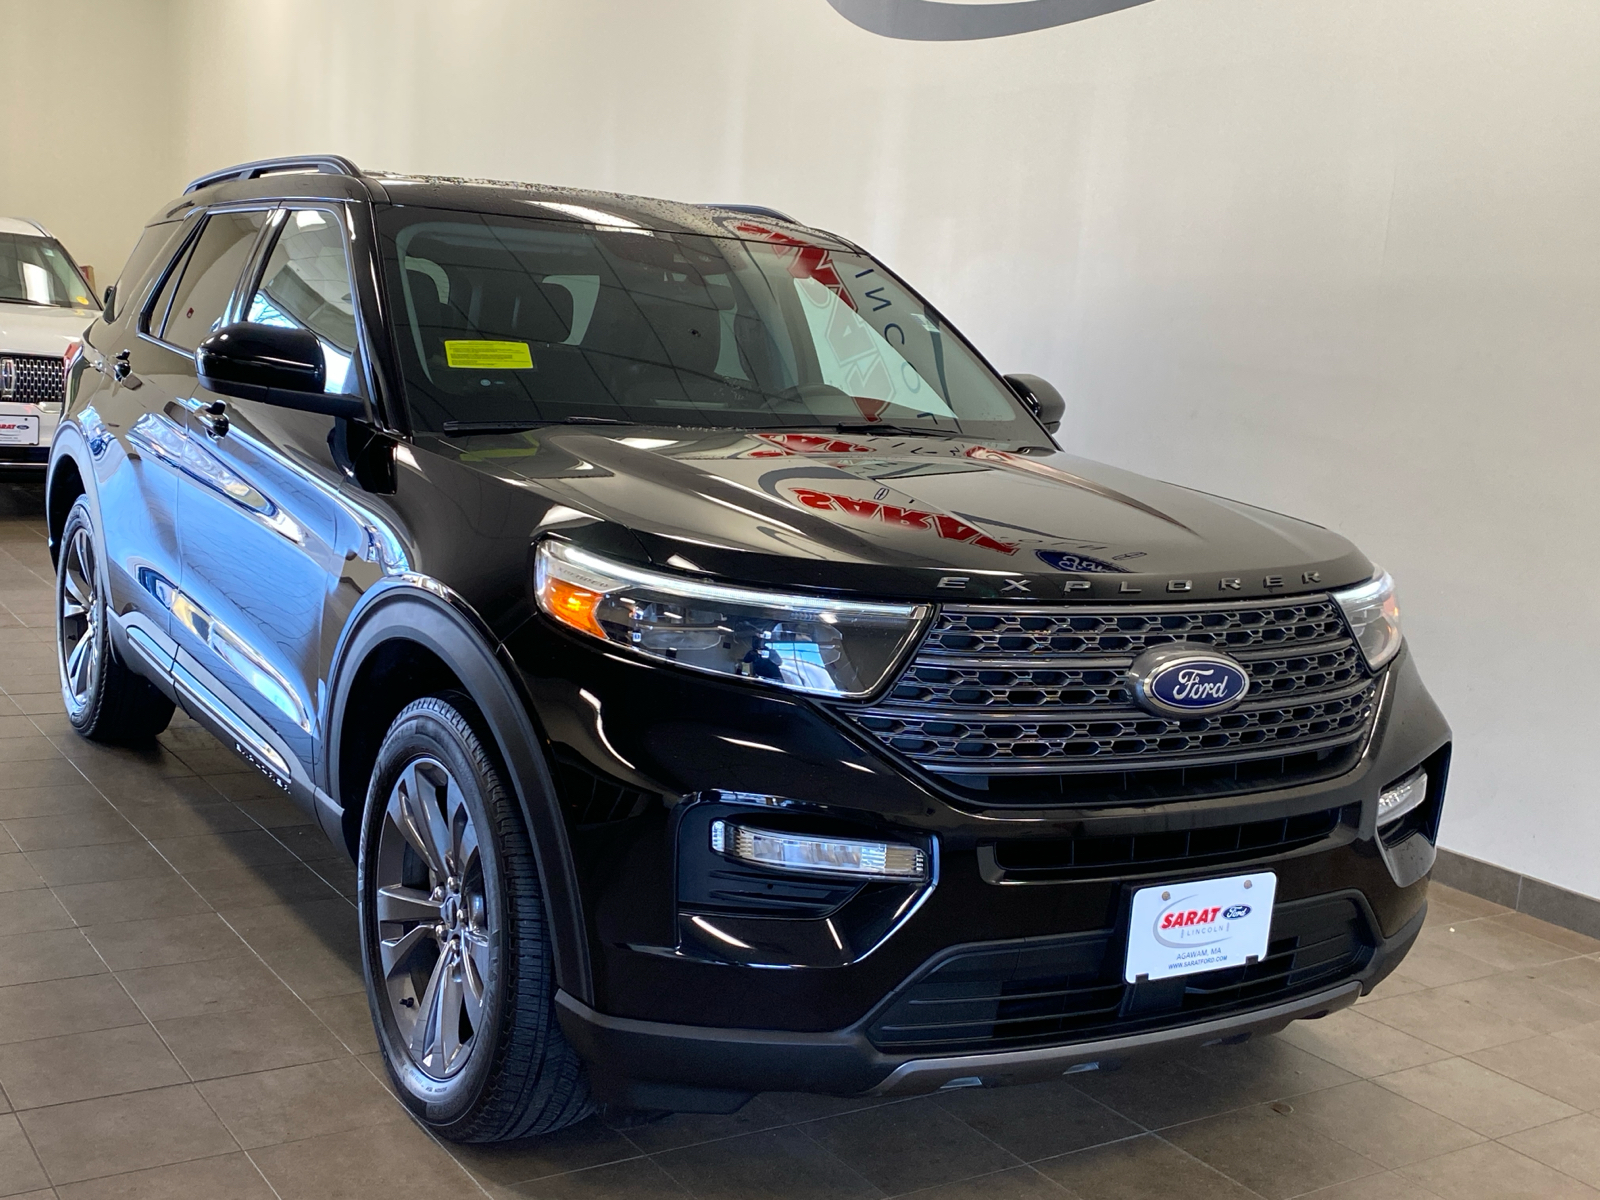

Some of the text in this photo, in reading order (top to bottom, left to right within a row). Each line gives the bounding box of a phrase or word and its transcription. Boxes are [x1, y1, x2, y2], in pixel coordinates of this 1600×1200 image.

[936, 571, 1322, 594] EXPLORER
[1173, 669, 1228, 700] Ford
[1161, 905, 1248, 930] SARAT Ford
[1186, 925, 1224, 937] LINCOLN
[1168, 955, 1228, 970] WWW.SARATFORD.COM
[1176, 947, 1222, 961] AGAWAM, MA
